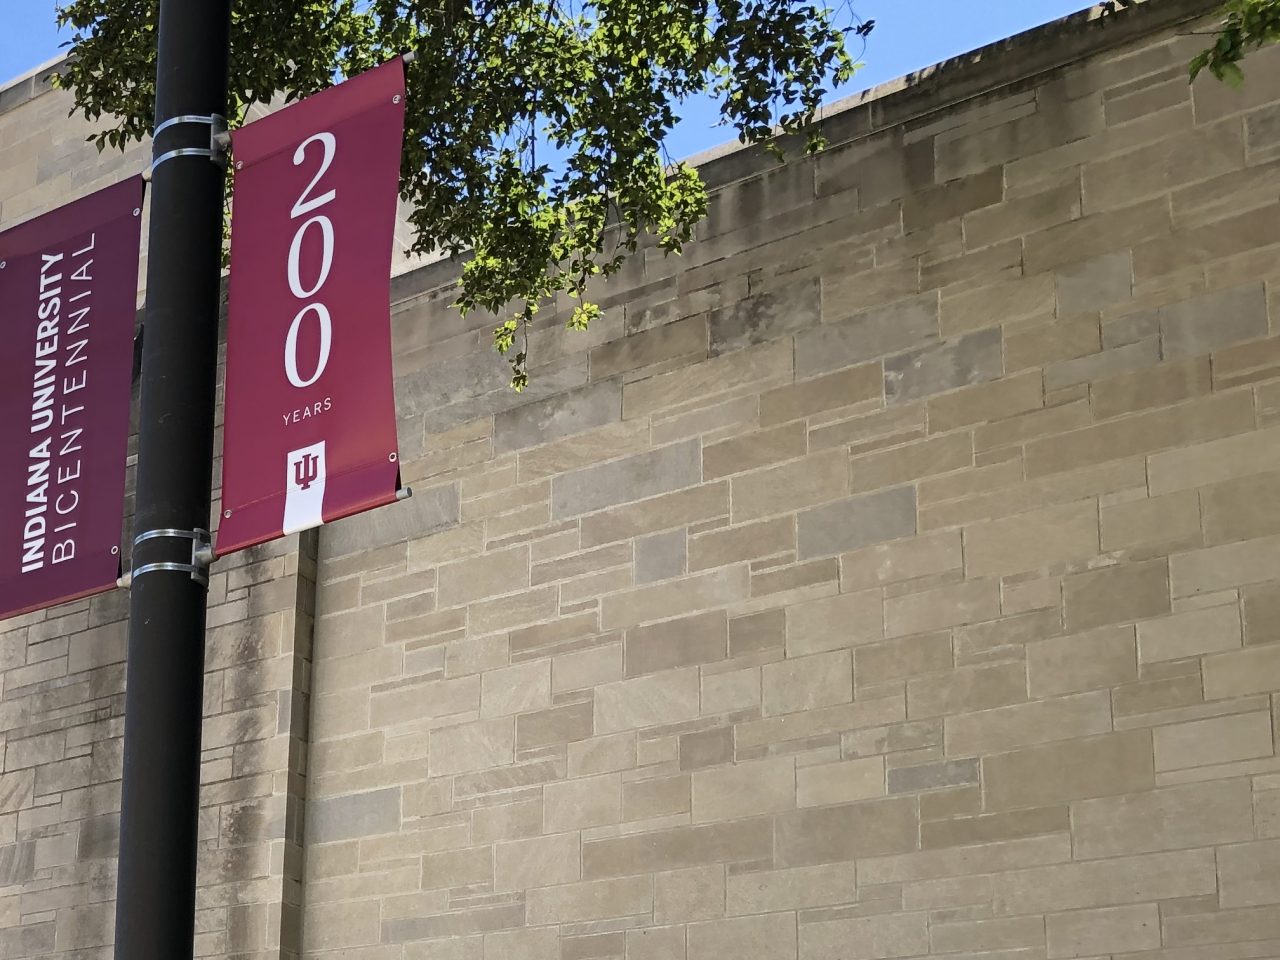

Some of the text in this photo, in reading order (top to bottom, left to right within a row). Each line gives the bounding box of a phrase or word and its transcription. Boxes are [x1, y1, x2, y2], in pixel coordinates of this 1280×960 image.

[52, 232, 96, 566] BICENTENNIAL
[284, 131, 337, 388] 200
[21, 252, 64, 574] INDIANA UNIVERSITY
[283, 397, 333, 427] YEARS
